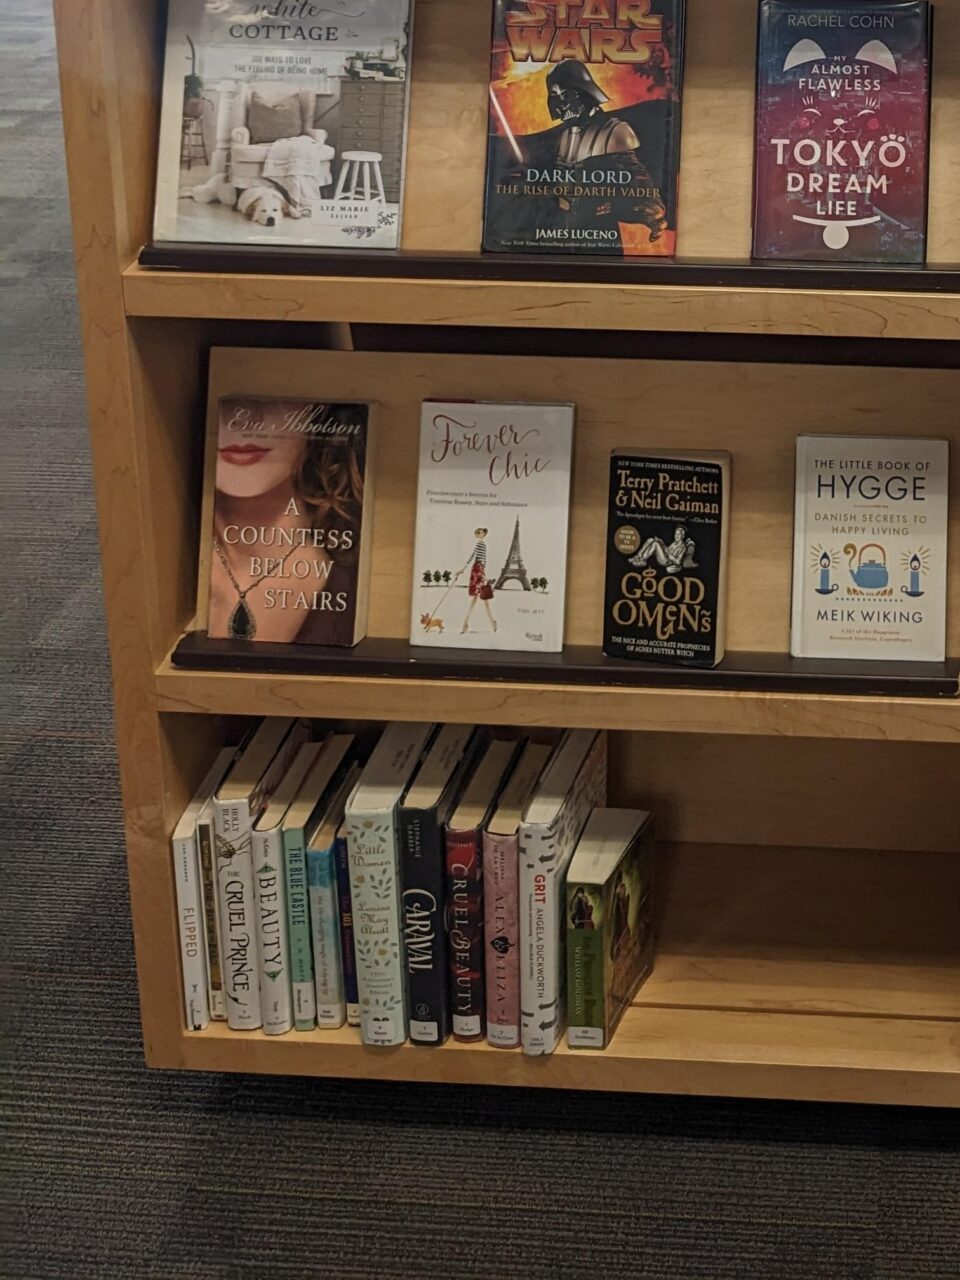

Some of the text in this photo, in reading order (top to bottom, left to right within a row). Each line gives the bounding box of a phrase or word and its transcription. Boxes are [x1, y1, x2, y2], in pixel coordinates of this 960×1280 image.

[229, 24, 338, 41] COTTAGE
[788, 15, 895, 28] RACHEL COHN
[506, 26, 662, 63] WARS
[811, 64, 869, 75] ALMOST
[799, 78, 881, 91] FLAWLESS
[526, 168, 632, 184] DARK LORD
[787, 174, 888, 194] DREAM
[496, 184, 660, 198] THE RISE OF DARTH VADER
[817, 201, 856, 216] LIFE
[536, 228, 618, 240] JAMES LUCENO
[227, 404, 362, 435] Eva Ibbotson
[431, 414, 540, 463] Forever
[489, 451, 551, 486] Chic
[815, 460, 930, 471] THE LITTLE BOOK OF
[617, 470, 719, 495] Terry Pratchett
[818, 475, 925, 501] HYGGE
[284, 497, 300, 516] A
[616, 490, 719, 514] & Neil Gaiman
[224, 525, 353, 550] COUNTESS
[250, 557, 335, 579] BELOW
[264, 590, 348, 612] STAIRS
[817, 610, 923, 623] MEIK WIKING
[289, 847, 305, 925] THE BLUE CASTLE
[534, 874, 546, 904] GRIT
[184, 908, 197, 957] FLIPPED
[259, 877, 282, 965] BEAUTY
[402, 888, 436, 974] CARAVAL
[225, 880, 253, 992] CRUEL PRINCE
[451, 863, 473, 1012] CRUEL BEAUTY
[536, 943, 544, 998] DUCKWORTH
